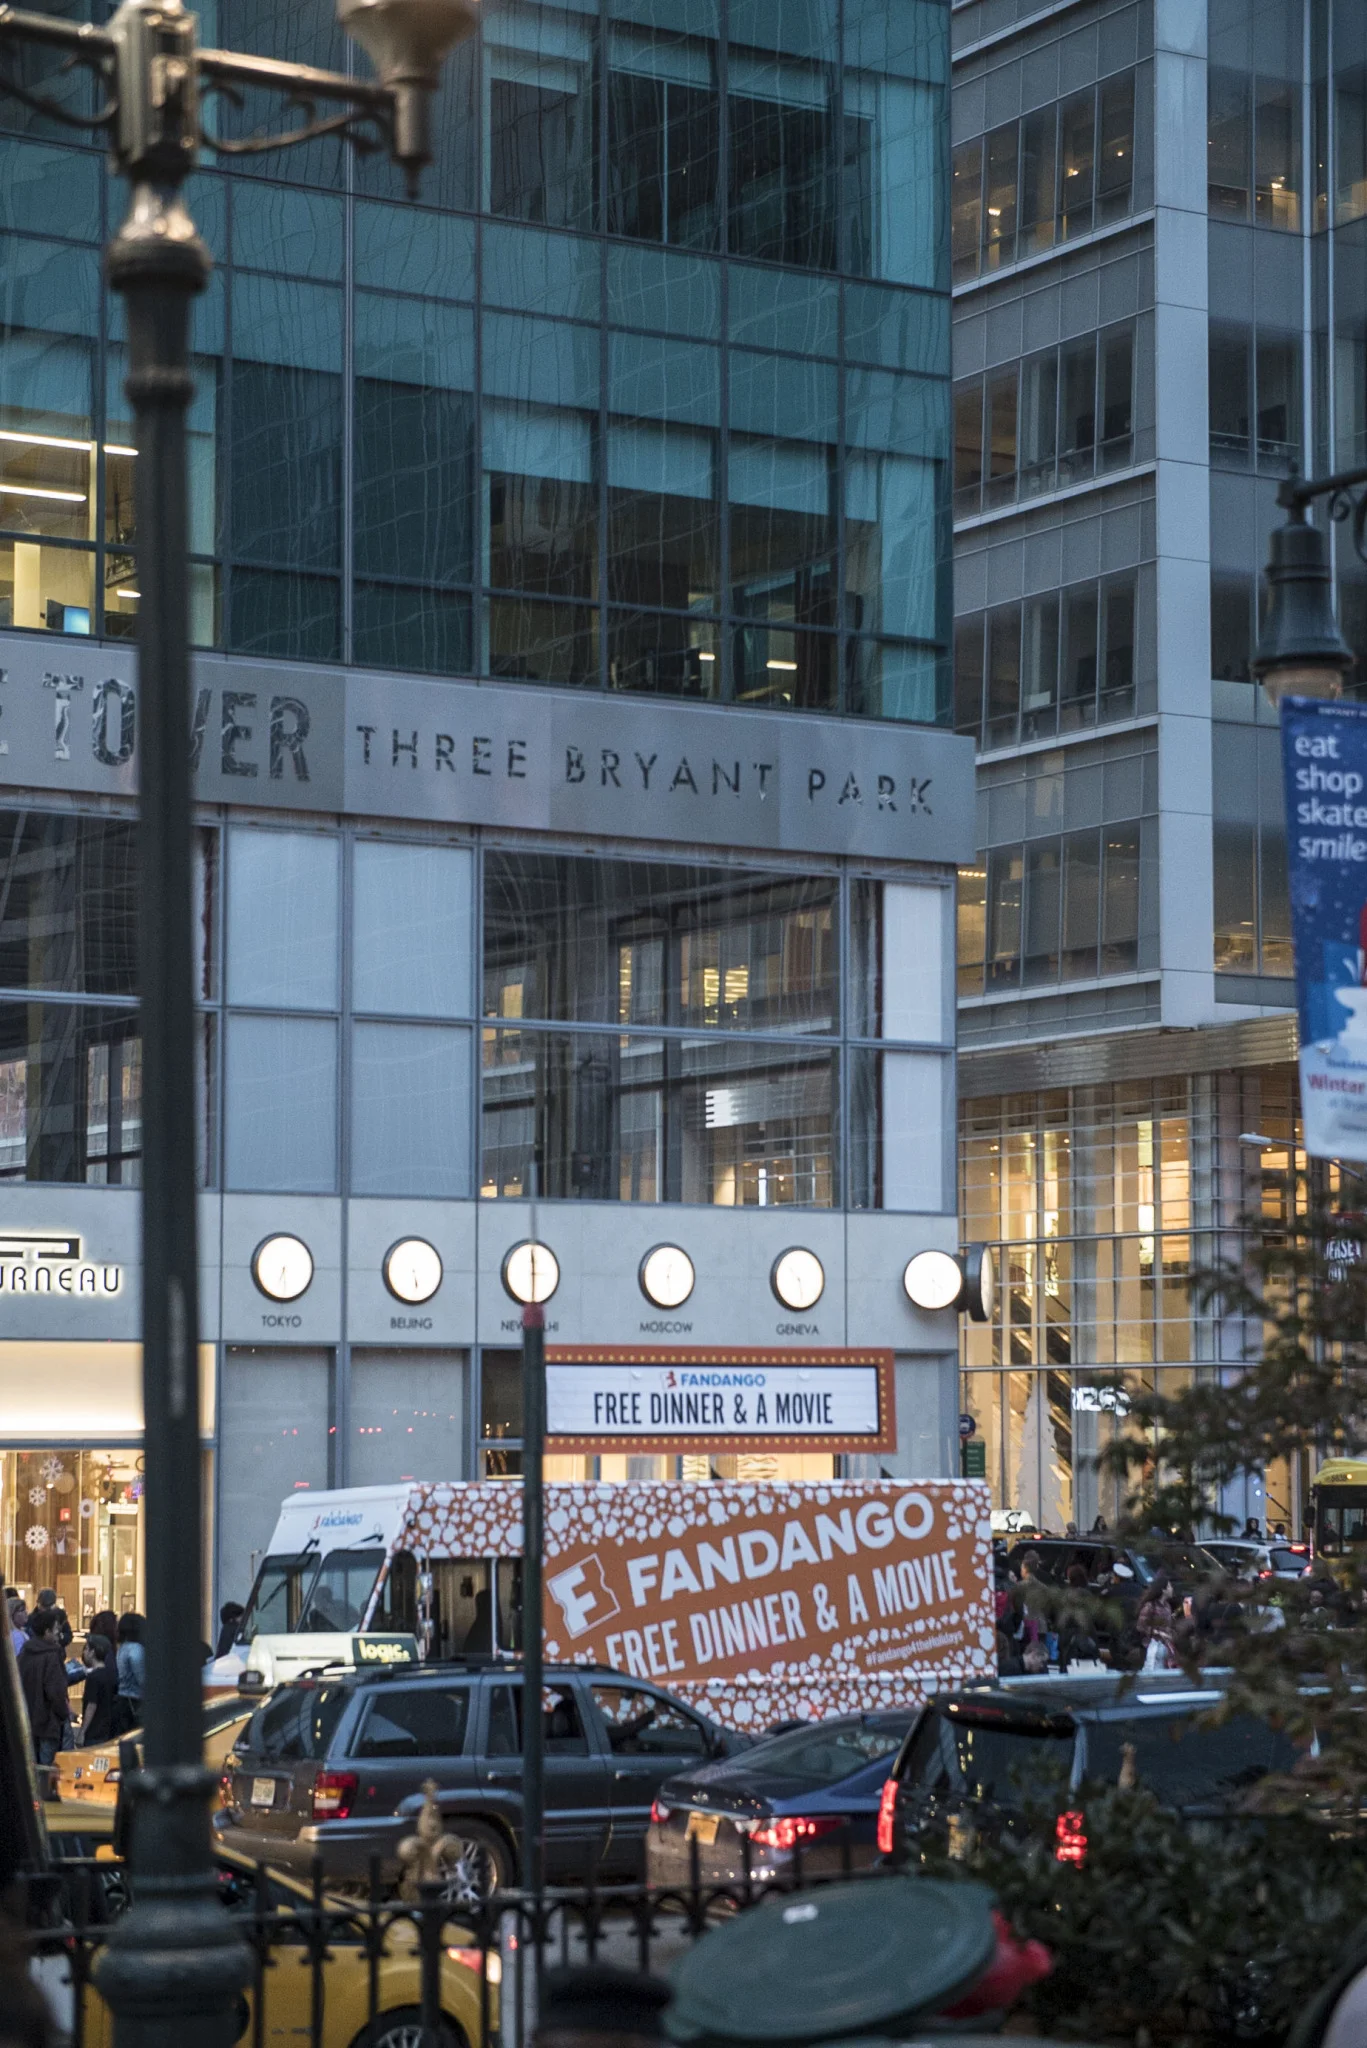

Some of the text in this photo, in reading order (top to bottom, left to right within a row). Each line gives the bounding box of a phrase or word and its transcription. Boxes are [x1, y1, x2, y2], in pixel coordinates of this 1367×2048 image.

[42, 671, 311, 782] TOER
[356, 725, 527, 778] THREE
[565, 745, 773, 800] BRYANT
[807, 767, 933, 816] PARK
[1295, 735, 1340, 759] eat
[1296, 763, 1364, 800] shop
[1297, 797, 1367, 829] skate
[1299, 831, 1367, 863] smile
[0, 1266, 120, 1292] RNEAU
[261, 1315, 302, 1328] TOKYO
[390, 1317, 433, 1330] BEIJING
[639, 1321, 693, 1333] MOSCOW
[776, 1323, 819, 1336] GENEVA
[681, 1373, 767, 1388] FANDANGO
[594, 1392, 834, 1426] FREE DINNER & A MOVIE
[625, 1491, 936, 1608] FANDANGO
[605, 1549, 964, 1679] FREE DINNER & A MOVIE
